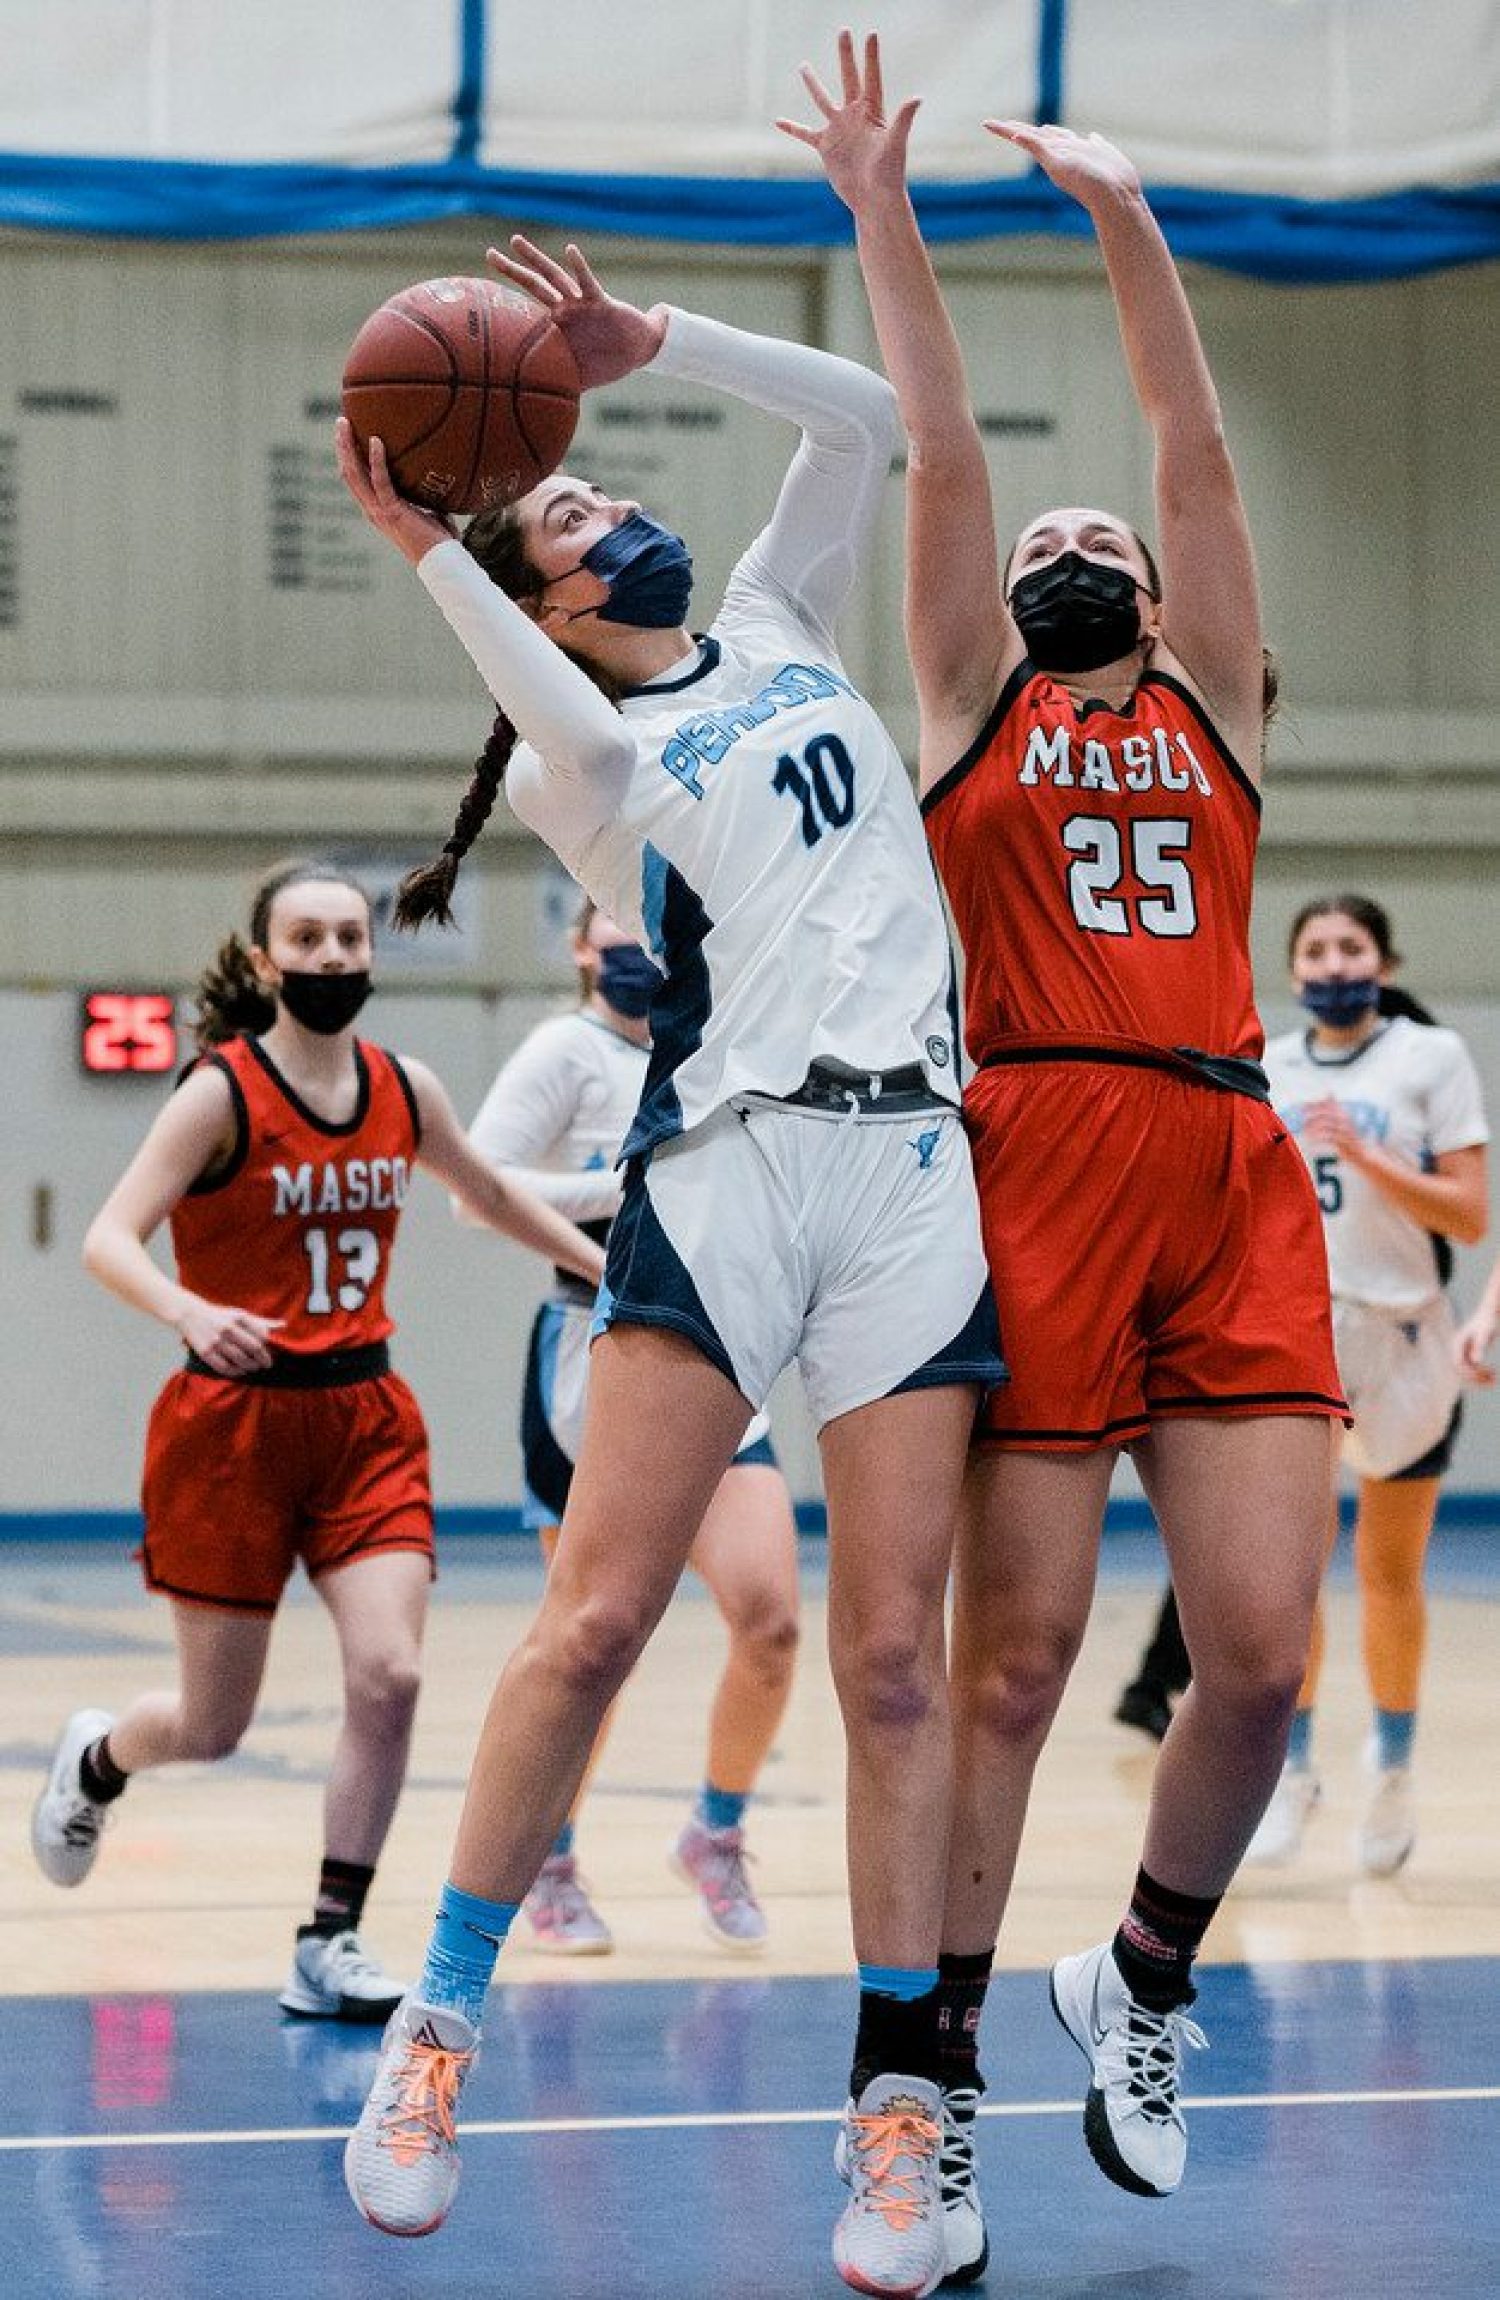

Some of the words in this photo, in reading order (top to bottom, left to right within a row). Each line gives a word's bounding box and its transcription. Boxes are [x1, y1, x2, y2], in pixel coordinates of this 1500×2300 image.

[772, 732, 856, 849] 10
[1061, 813, 1198, 938] 25
[84, 994, 176, 1071] 25
[271, 1155, 410, 1217] MASCO
[304, 1227, 381, 1315] 13
